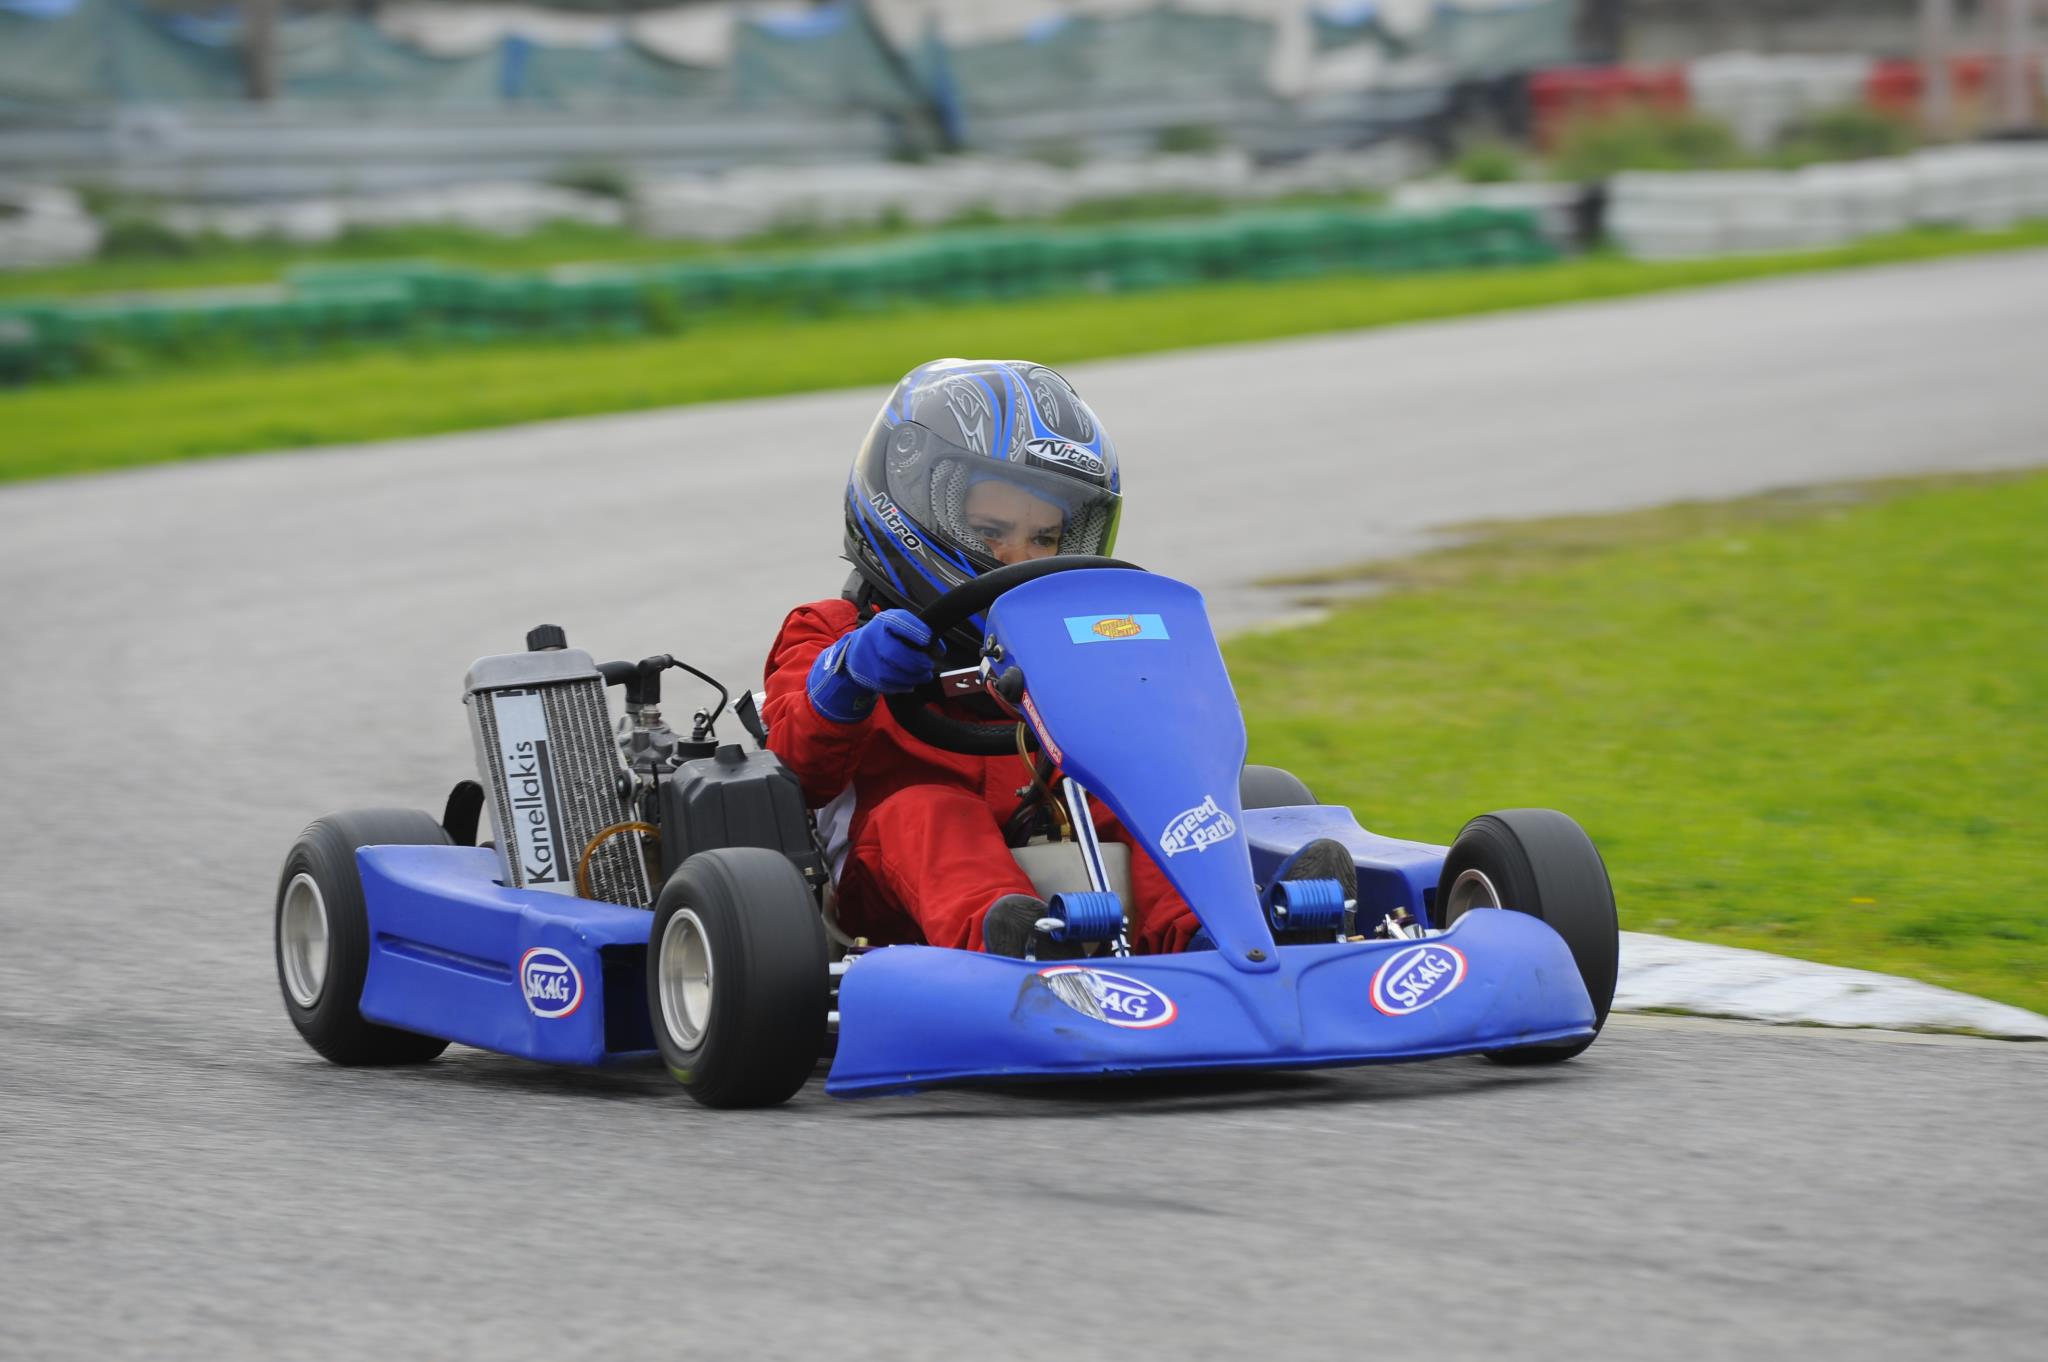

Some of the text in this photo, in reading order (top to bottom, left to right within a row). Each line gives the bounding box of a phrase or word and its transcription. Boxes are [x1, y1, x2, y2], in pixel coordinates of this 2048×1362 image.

[1039, 440, 1100, 471] Nitro
[870, 492, 921, 550] Nitro
[509, 741, 555, 884] Kanellakis
[1160, 794, 1217, 857] Speed
[526, 963, 570, 1002] SKAG
[1092, 979, 1151, 1018] AG
[1386, 948, 1452, 1007] SKAG
